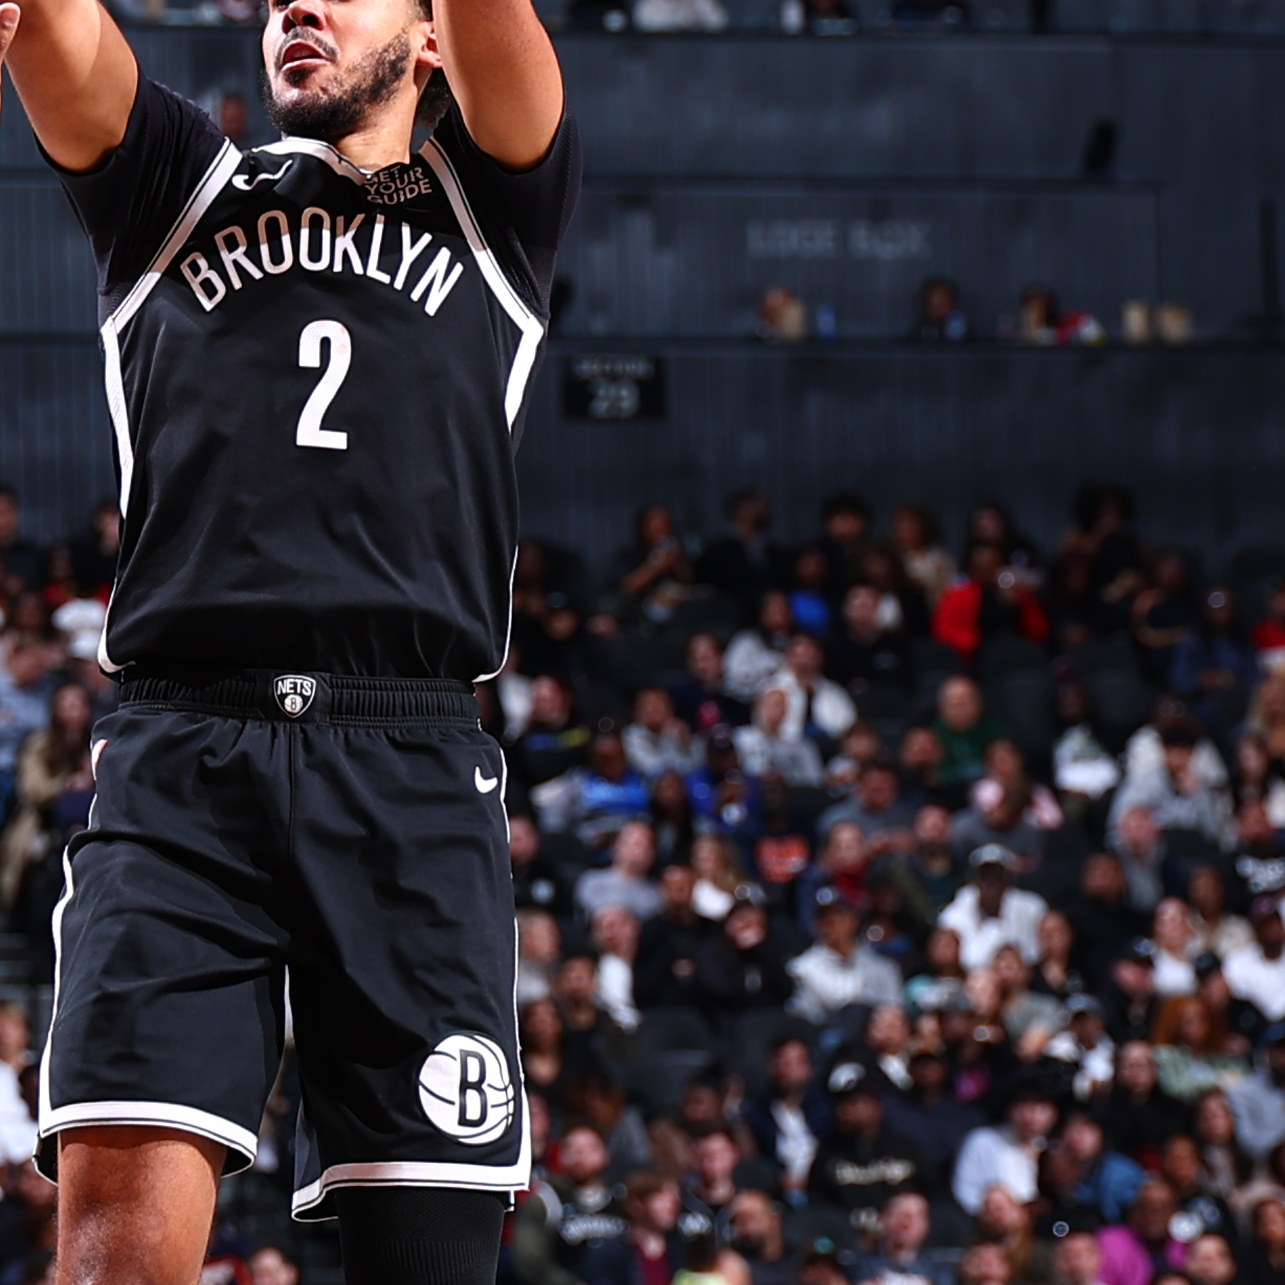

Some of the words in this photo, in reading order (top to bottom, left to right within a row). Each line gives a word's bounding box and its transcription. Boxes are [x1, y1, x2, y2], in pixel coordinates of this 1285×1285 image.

[364, 167, 425, 195] YOUR
[367, 179, 433, 205] GUIDE
[179, 206, 464, 317] BROOKLYN
[296, 319, 353, 450] 2
[277, 678, 312, 696] NETS
[457, 1049, 489, 1128] B
